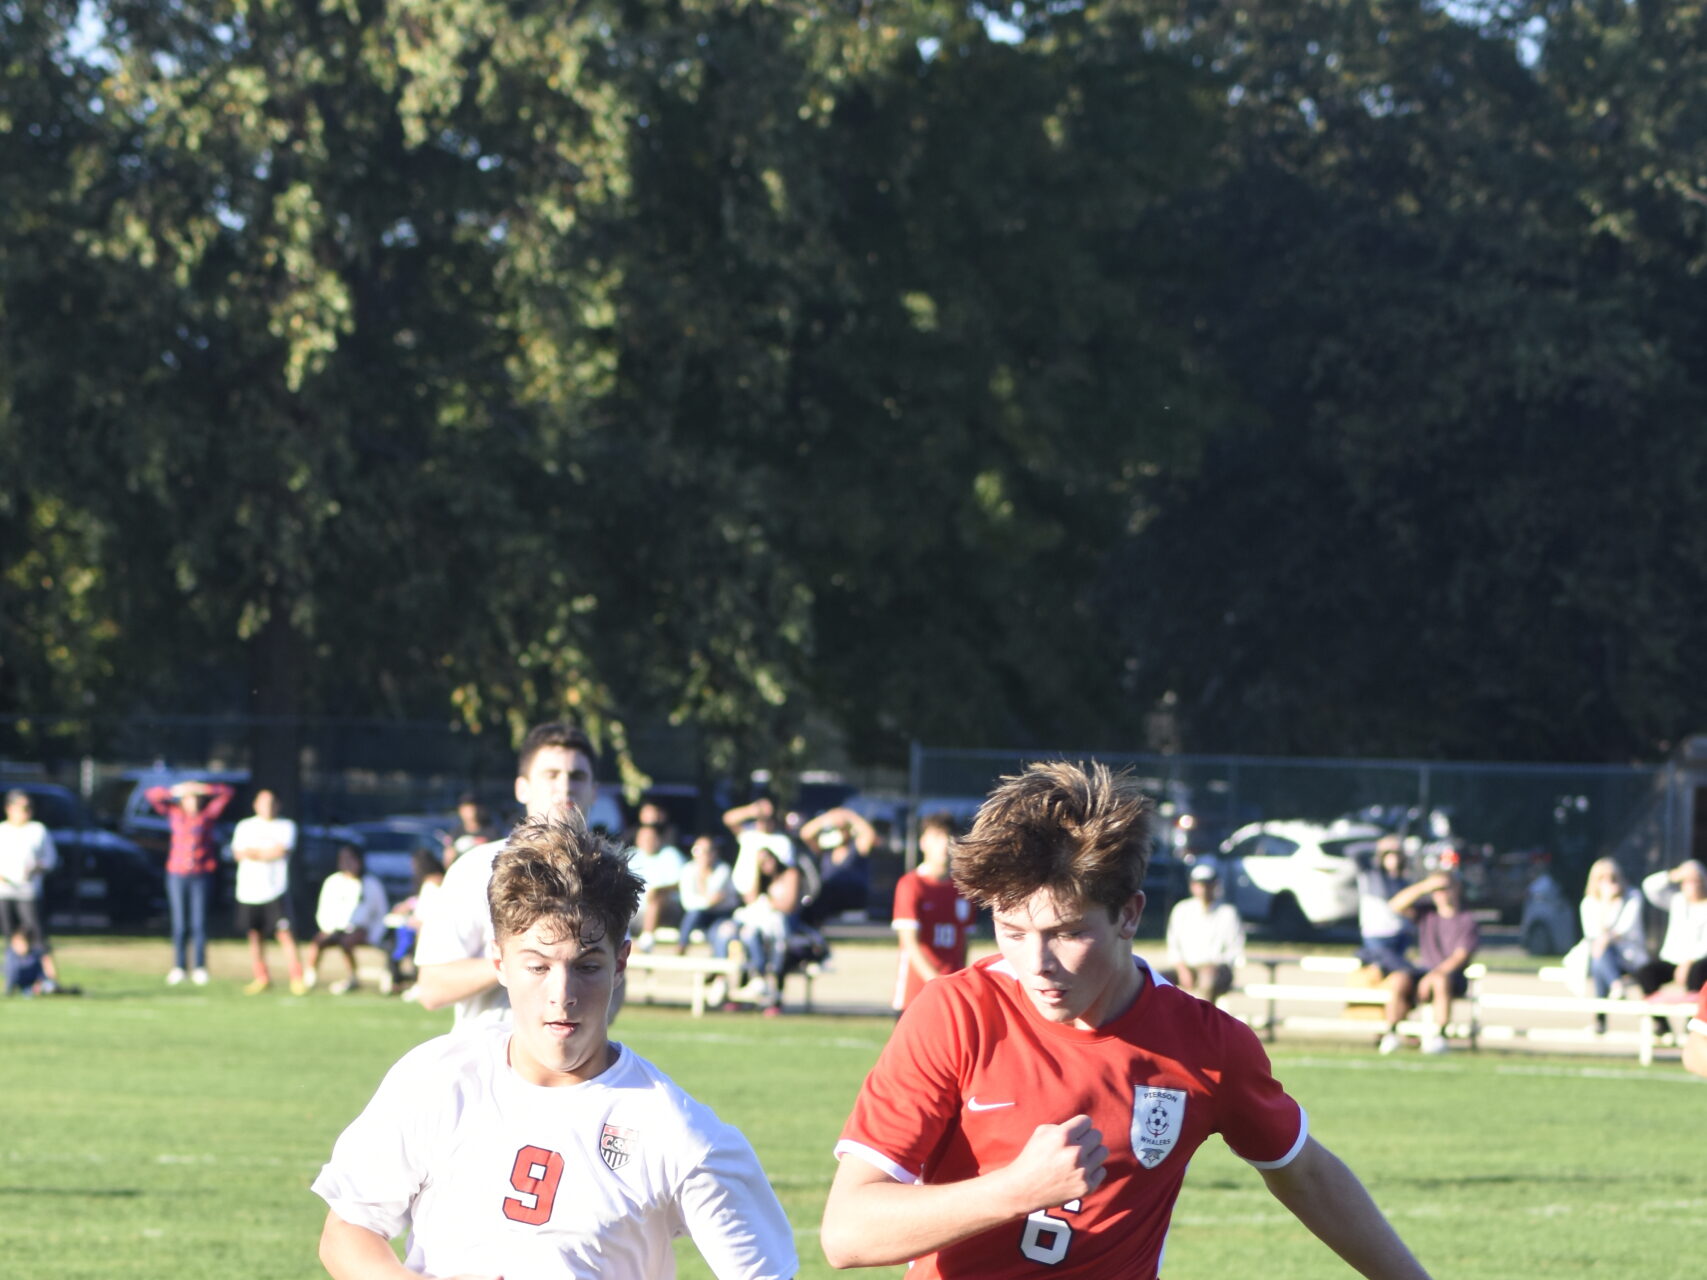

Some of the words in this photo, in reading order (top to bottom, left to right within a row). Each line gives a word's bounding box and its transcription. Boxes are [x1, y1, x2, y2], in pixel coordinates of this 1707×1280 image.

[1143, 1091, 1178, 1103] PIERSON
[1140, 1135, 1171, 1146] WHALERS
[502, 1144, 565, 1226] 9
[1020, 1199, 1081, 1266] 6
